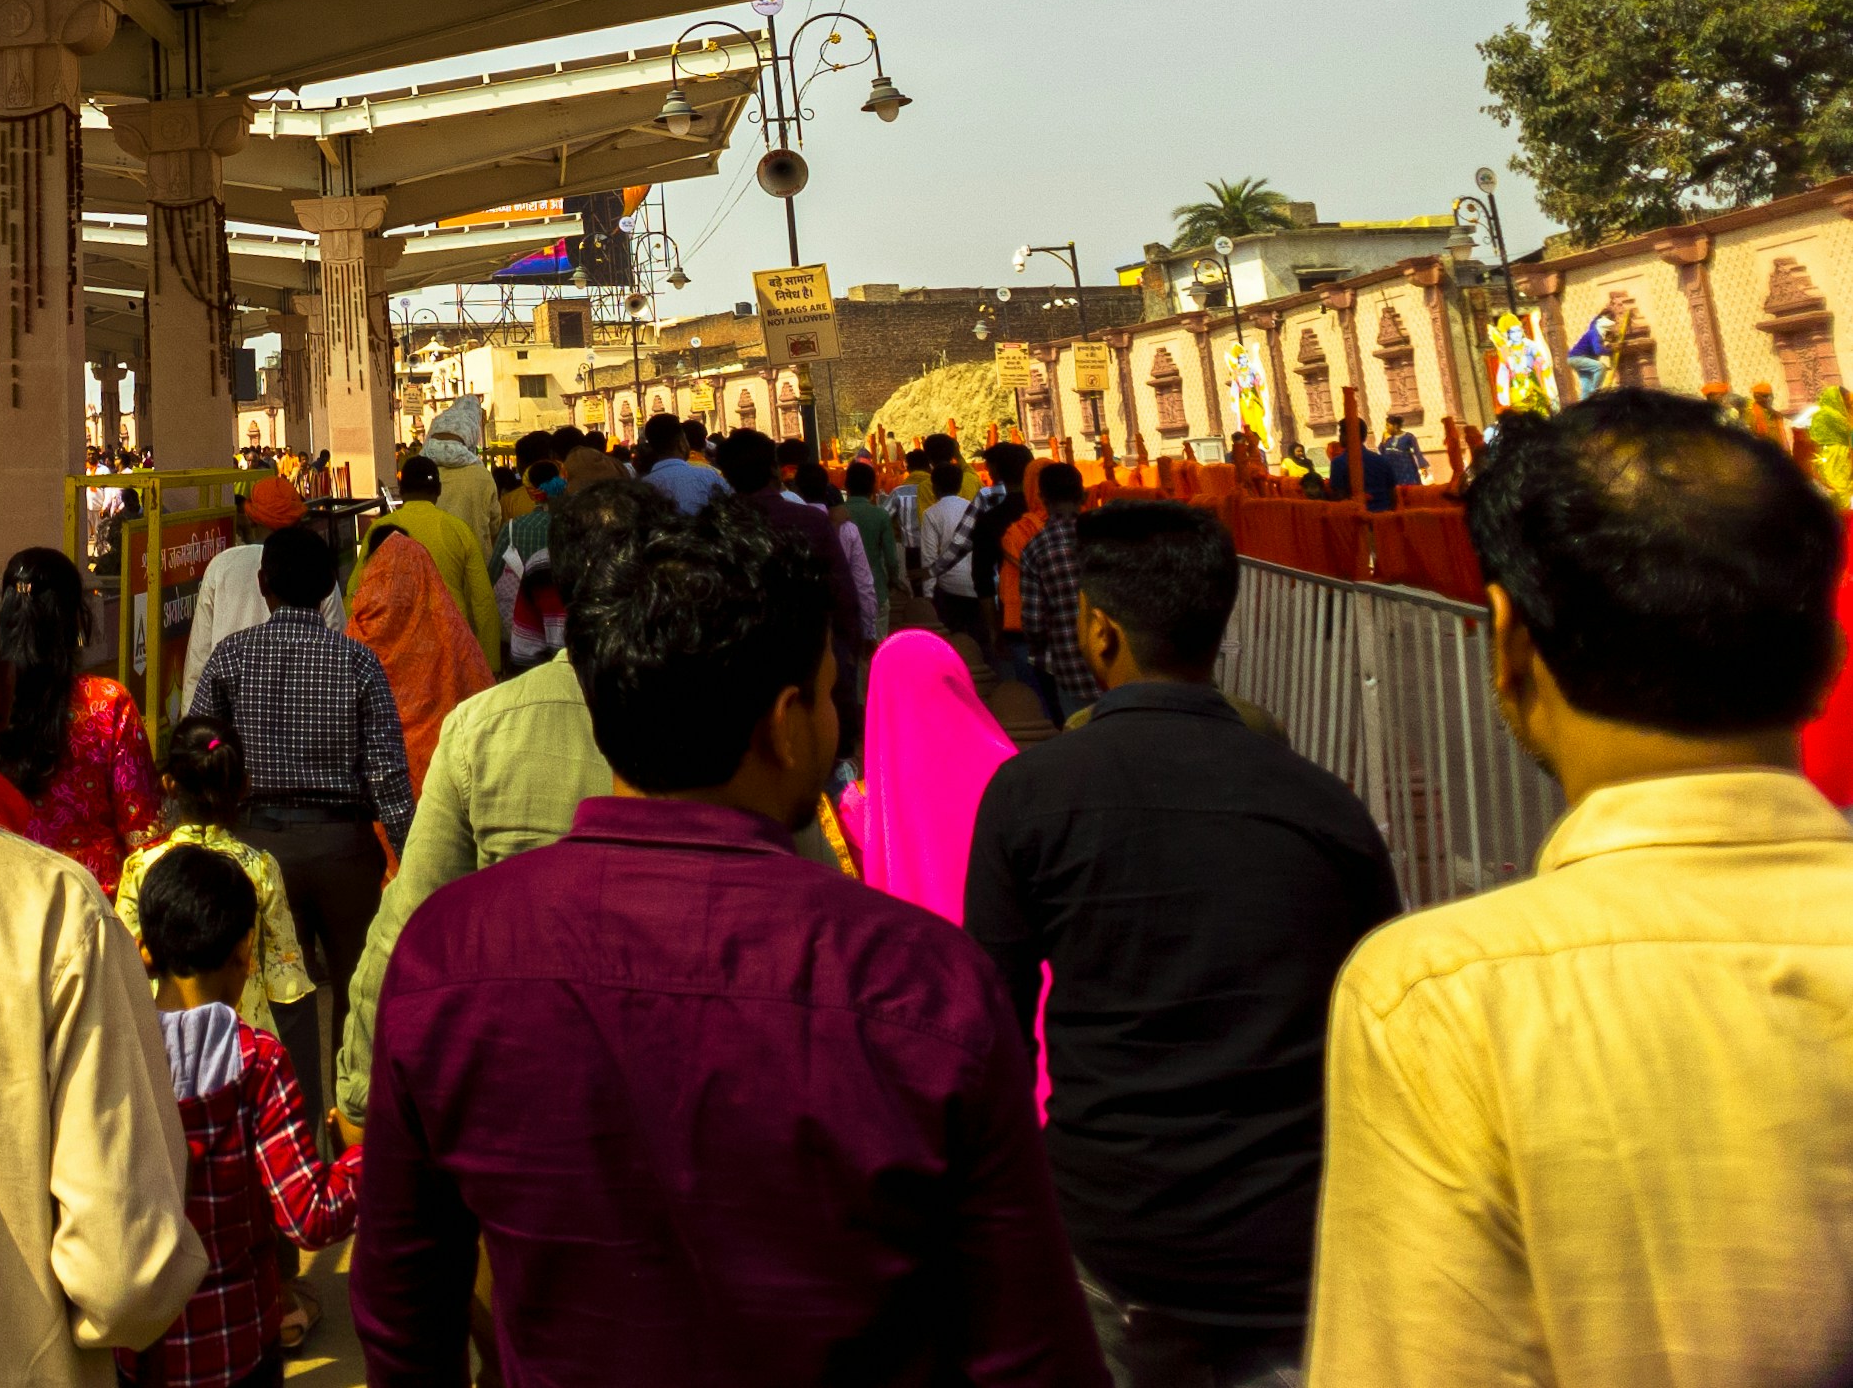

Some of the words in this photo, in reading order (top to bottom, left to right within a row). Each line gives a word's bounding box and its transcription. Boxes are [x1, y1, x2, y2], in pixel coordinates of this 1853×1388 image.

[768, 276, 783, 289] बड़े
[784, 274, 814, 286] सामान
[767, 308, 782, 317] BIG
[783, 305, 808, 315] BAGS
[809, 303, 828, 312] ARE
[767, 318, 786, 327] NOT
[788, 313, 831, 325] ALLOWED
